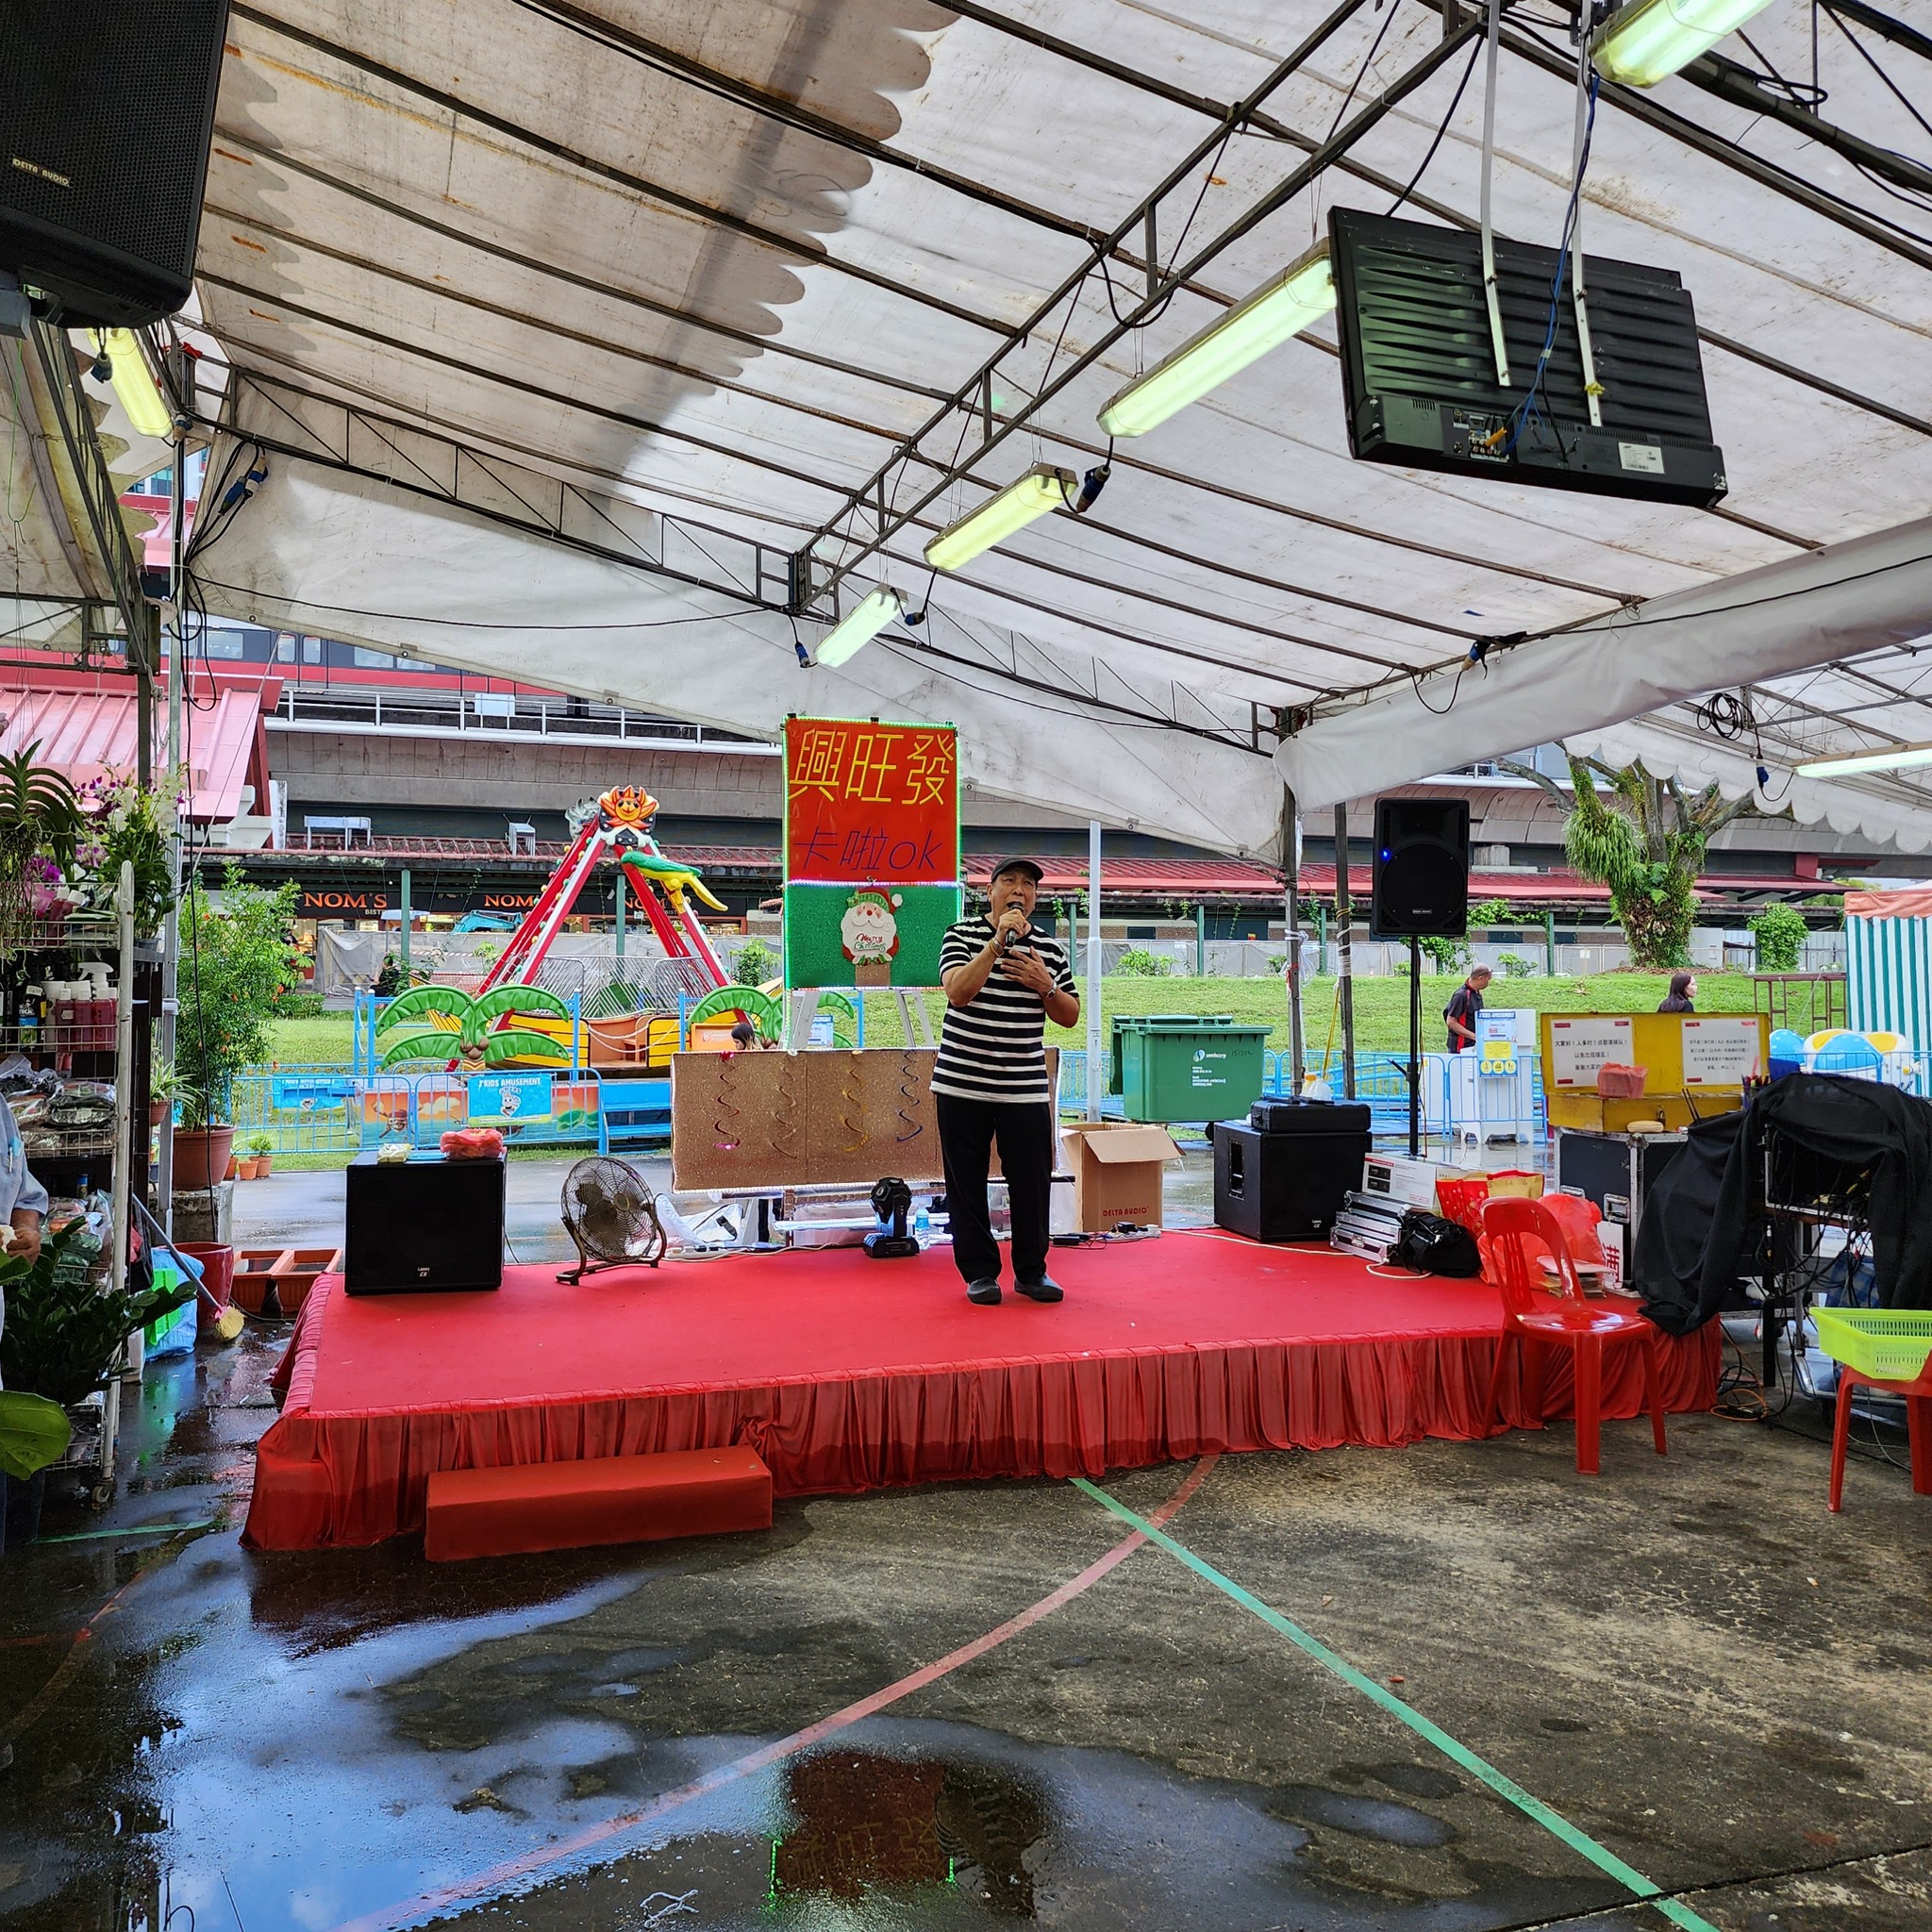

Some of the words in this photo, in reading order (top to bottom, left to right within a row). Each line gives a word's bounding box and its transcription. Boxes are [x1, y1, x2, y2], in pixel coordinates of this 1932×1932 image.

[42, 170, 69, 186] AUDIO
[789, 727, 954, 806] 興旺發
[303, 892, 388, 908] NOM'S
[501, 1077, 541, 1087] AMUSEMENT
[1103, 1208, 1124, 1217] DELTA
[1124, 1207, 1147, 1215] AUDIO
